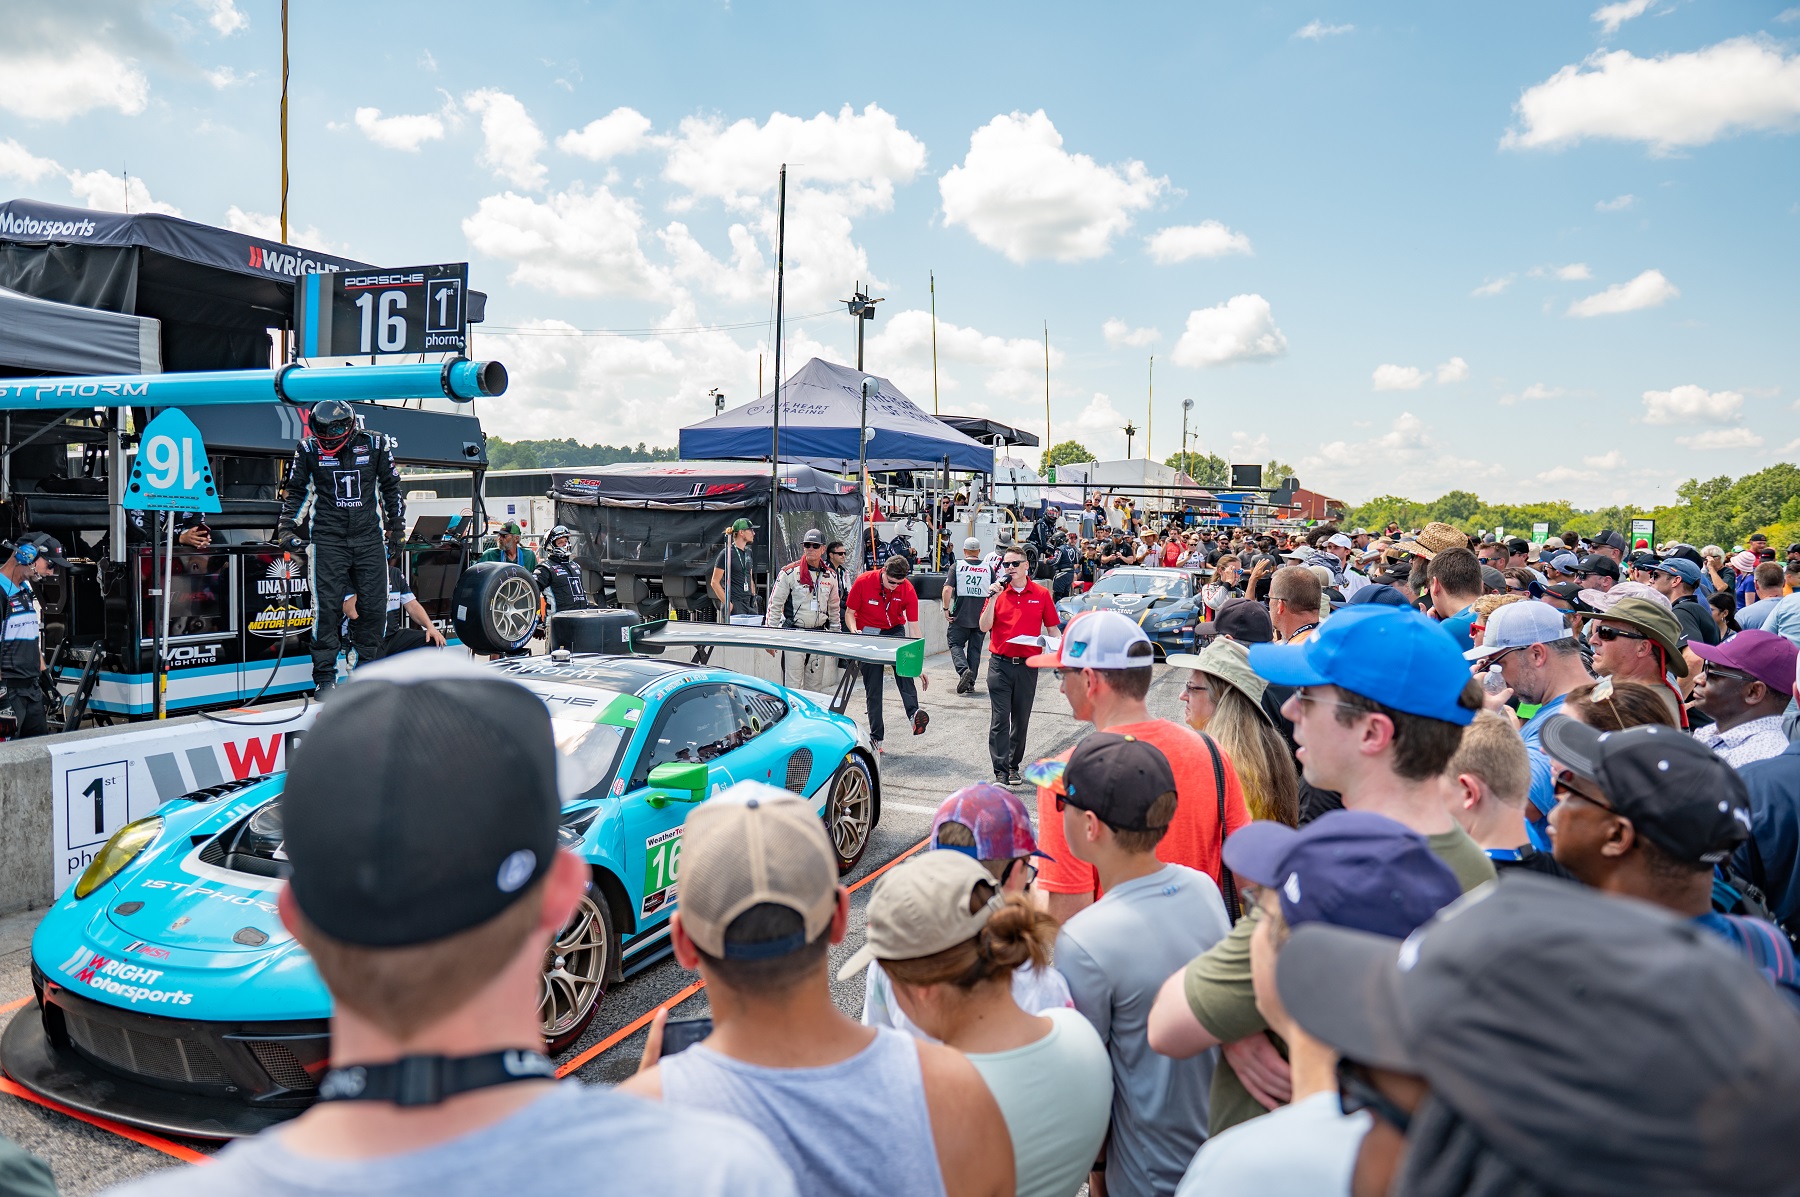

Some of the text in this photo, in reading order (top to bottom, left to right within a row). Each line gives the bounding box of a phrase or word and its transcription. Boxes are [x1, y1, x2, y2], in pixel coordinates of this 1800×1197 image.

[0, 212, 96, 240] Motorsports
[345, 273, 424, 286] PORSCHE
[355, 290, 407, 352] 16
[426, 334, 458, 348] phorm
[35, 382, 150, 401] PHORM
[793, 402, 829, 410] HEART
[1535, 535, 1545, 544] 27
[257, 580, 281, 595] UNA
[966, 574, 982, 586] 247
[966, 586, 982, 596] VIDEO
[159, 644, 222, 661] VOLT
[170, 656, 217, 667] IGHTING
[500, 662, 599, 680] phorm
[652, 839, 682, 889] 16
[141, 879, 280, 915] 1ST PHOR
[74, 967, 194, 1005] Motorsports
